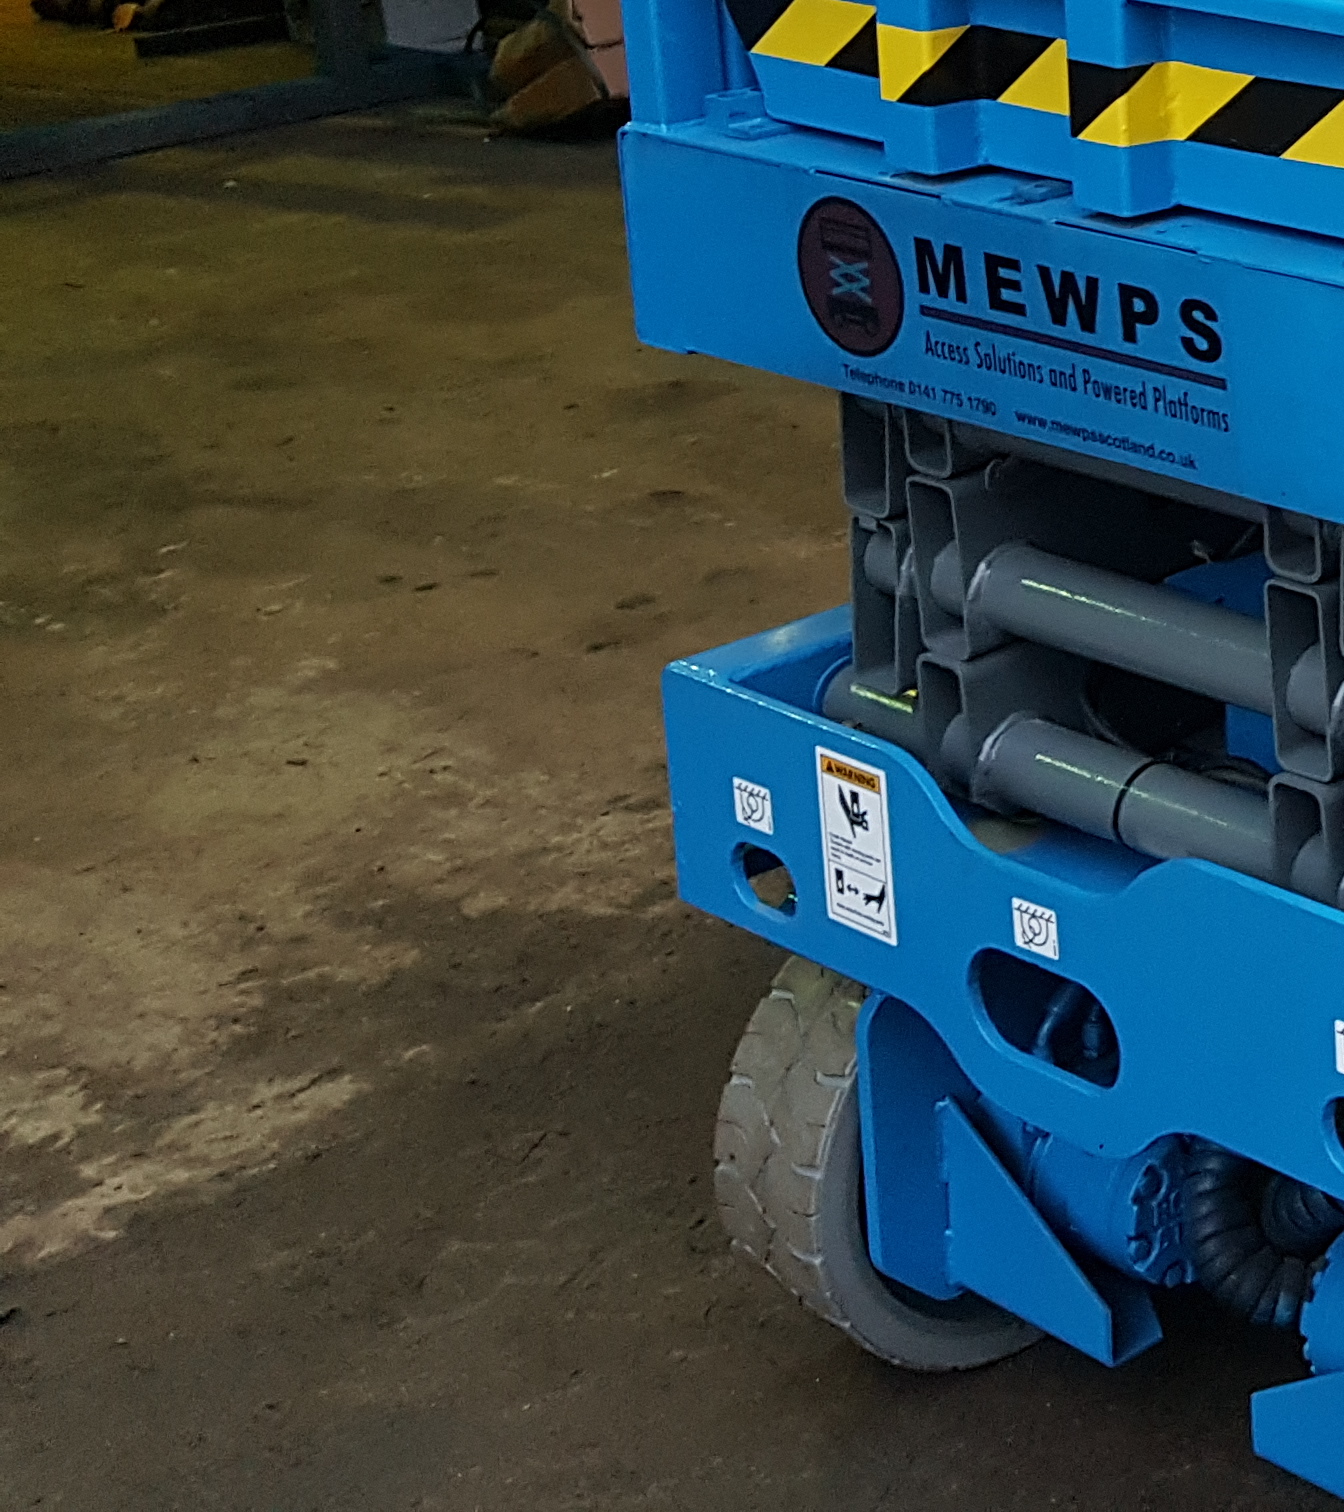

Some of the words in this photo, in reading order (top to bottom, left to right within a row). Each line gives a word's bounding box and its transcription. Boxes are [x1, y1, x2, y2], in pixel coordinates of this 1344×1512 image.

[913, 236, 1223, 364] MEWPS
[842, 363, 906, 393] Telephone
[909, 379, 937, 400] 0141
[941, 389, 964, 408] 775
[967, 395, 997, 416] 1790
[925, 330, 970, 366] Access
[974, 340, 1045, 384] Solutions
[1049, 363, 1077, 391] and
[1082, 367, 1148, 411] Powered
[1153, 386, 1230, 433] Platforms
[836, 766, 876, 789] WARNING
